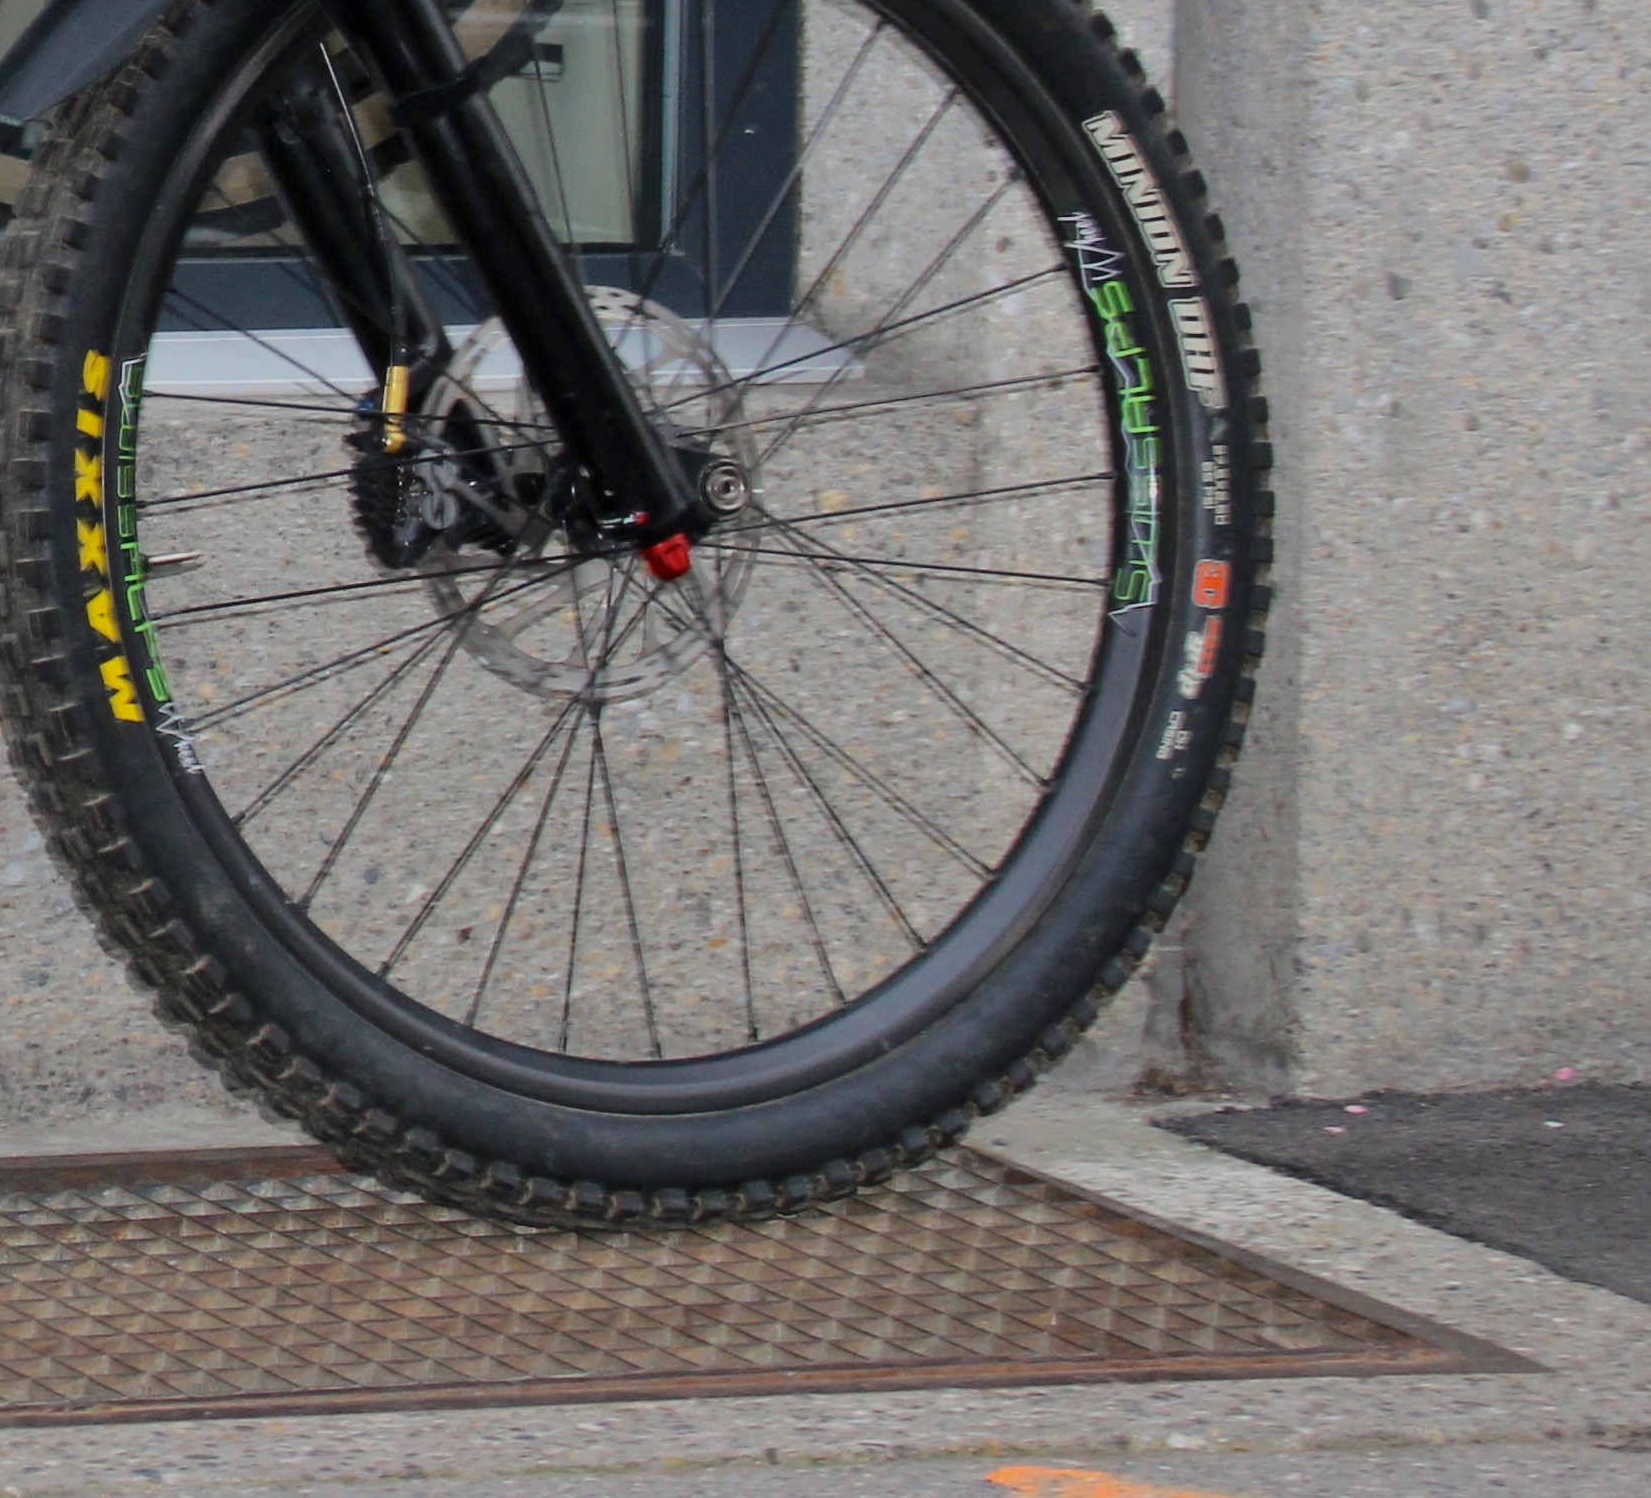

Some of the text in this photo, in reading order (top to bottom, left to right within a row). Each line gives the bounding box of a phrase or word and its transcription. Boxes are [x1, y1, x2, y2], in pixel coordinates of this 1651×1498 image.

[1081, 109, 1228, 411] MINION DHF
[73, 349, 146, 723] MAXXIS
